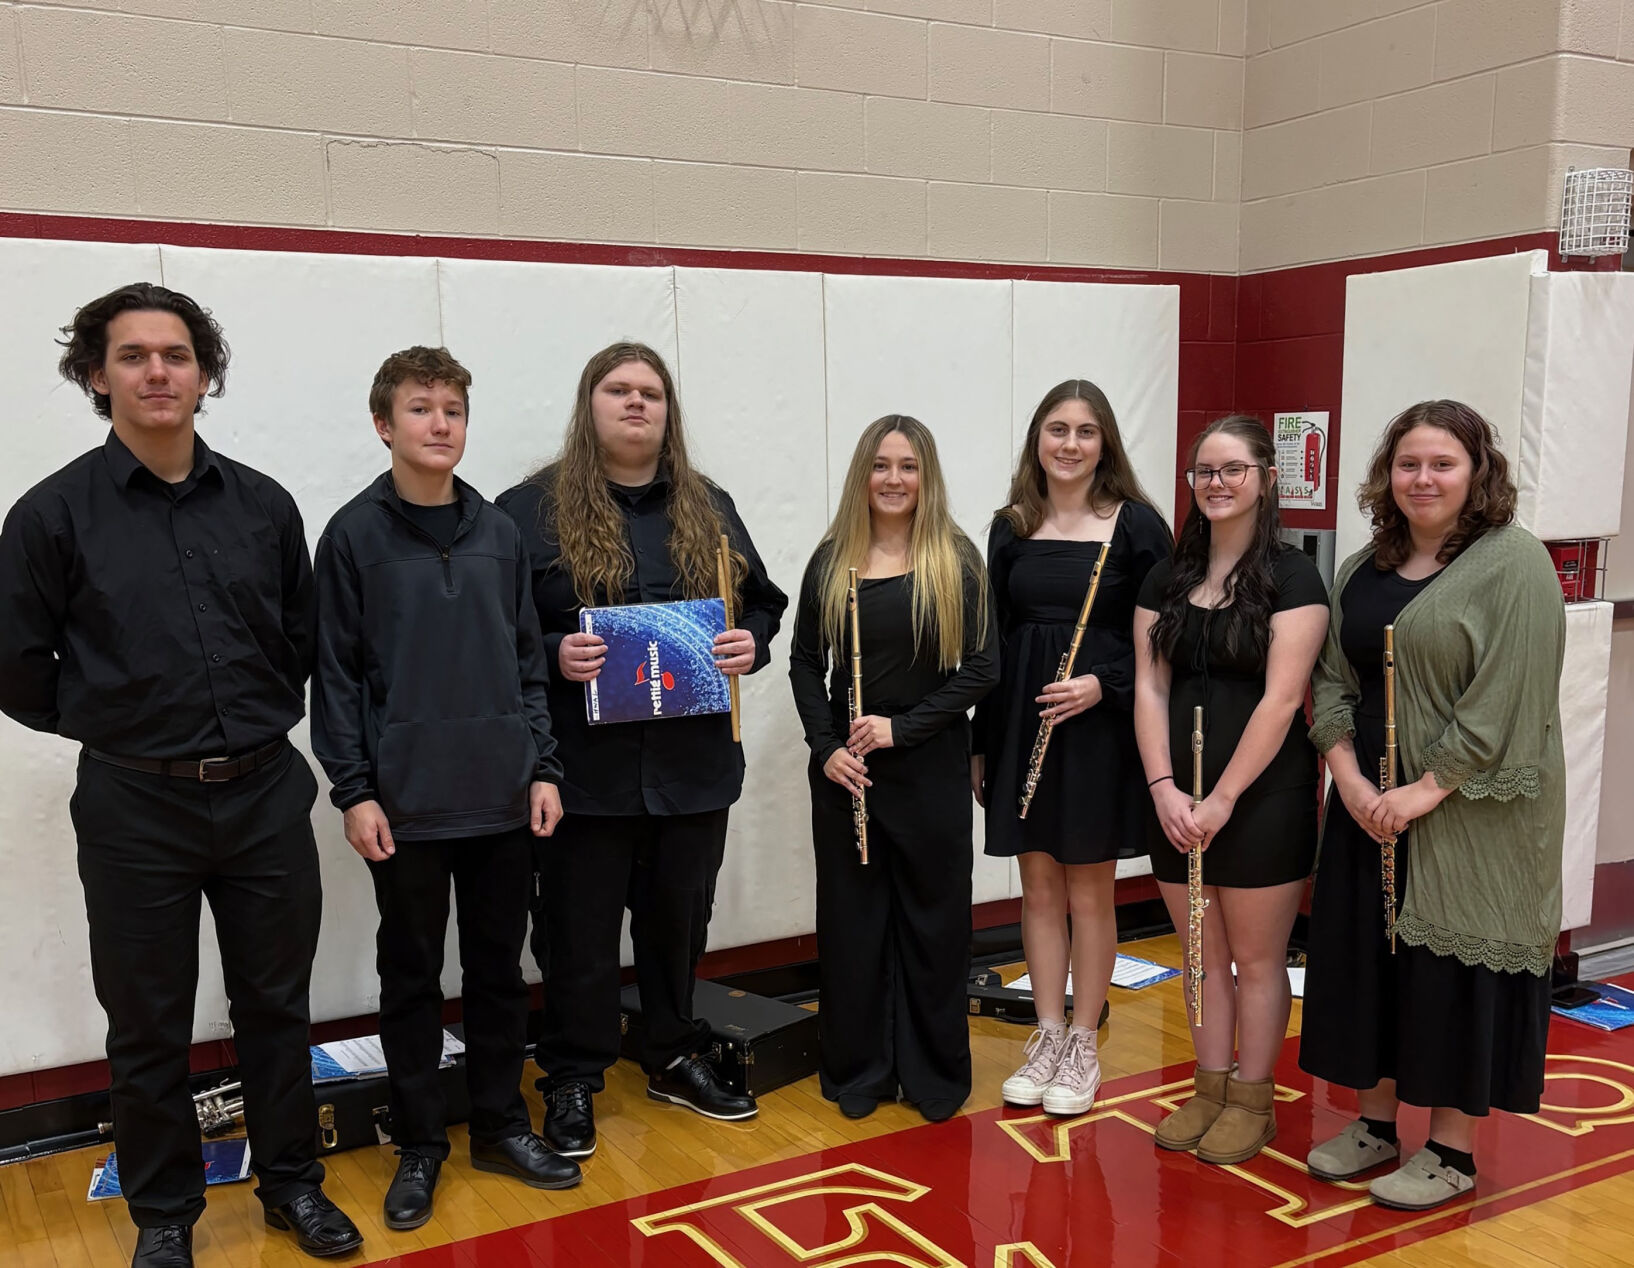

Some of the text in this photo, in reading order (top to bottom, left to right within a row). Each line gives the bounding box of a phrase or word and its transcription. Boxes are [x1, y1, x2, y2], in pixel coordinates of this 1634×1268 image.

[1278, 416, 1302, 430] FIRE
[1277, 433, 1301, 442] SAFETY
[647, 640, 660, 678] music
